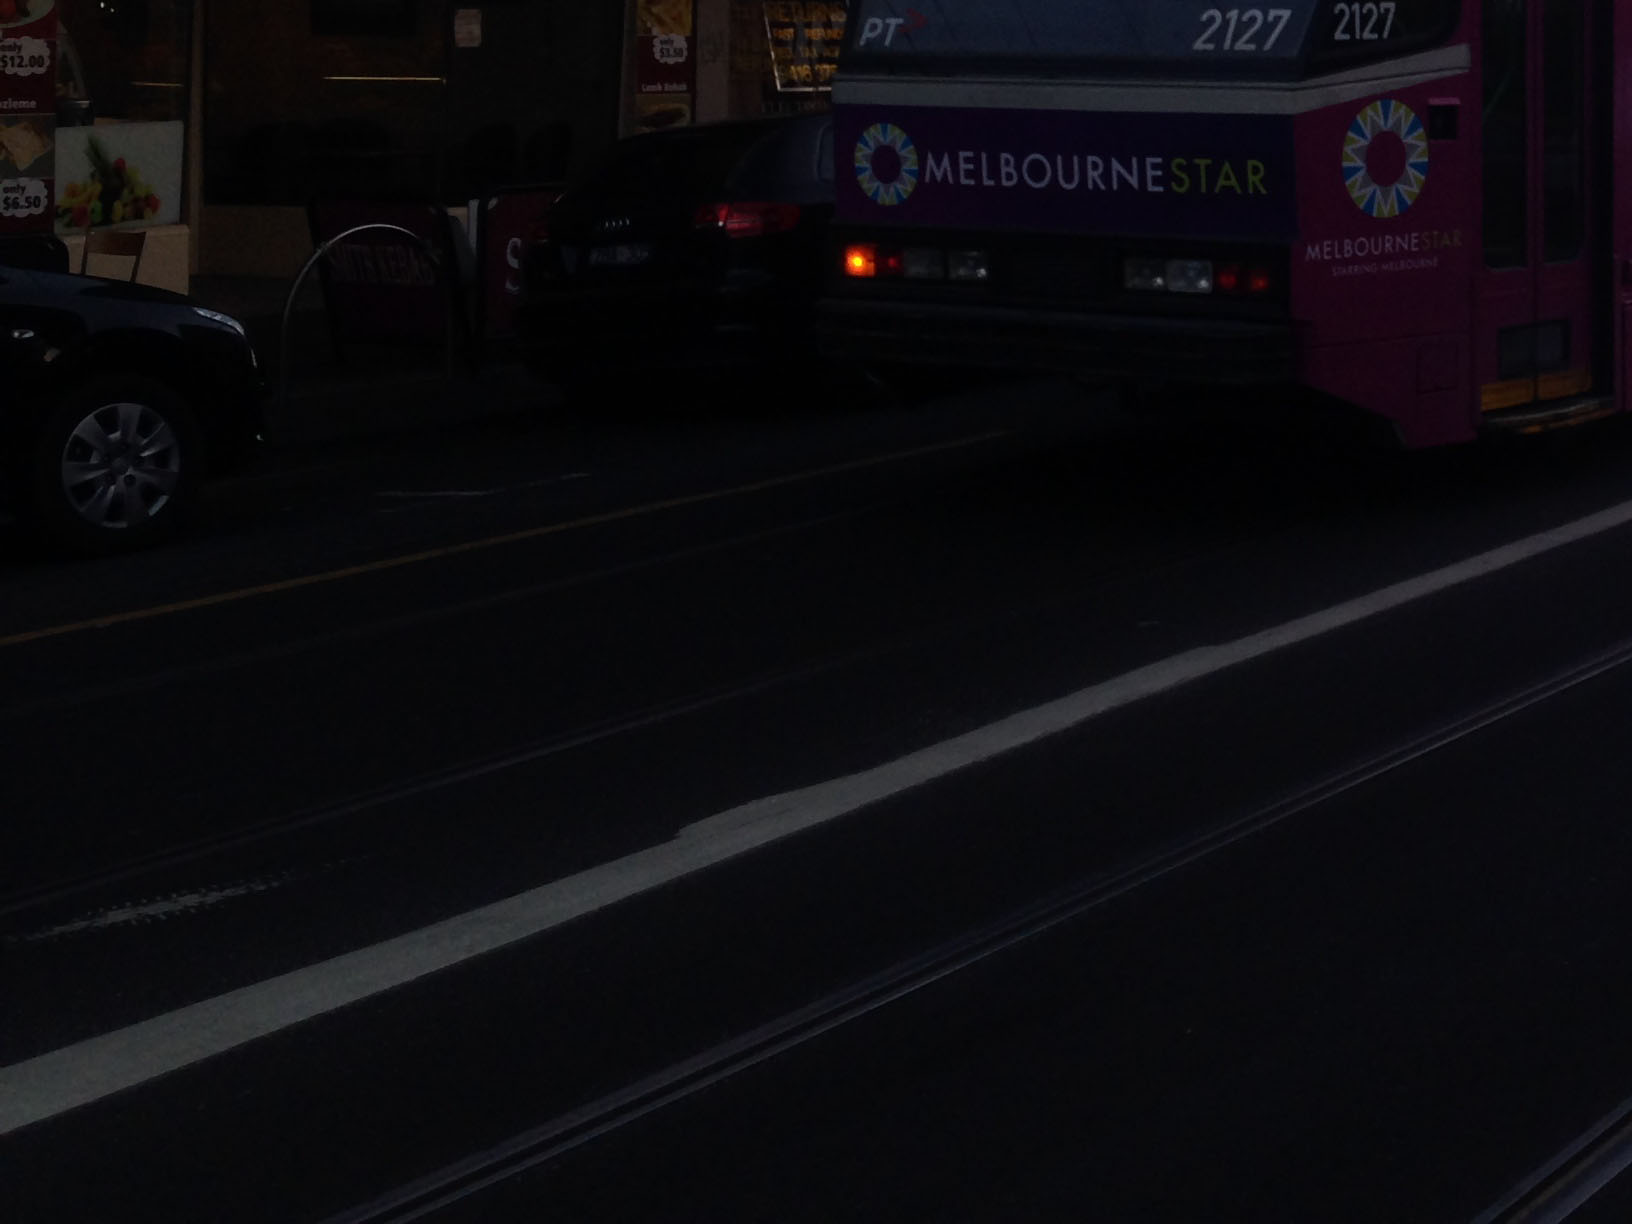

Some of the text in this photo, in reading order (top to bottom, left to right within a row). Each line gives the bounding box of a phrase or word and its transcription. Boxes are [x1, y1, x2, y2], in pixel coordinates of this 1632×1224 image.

[860, 17, 904, 47] PT
[1193, 2, 1396, 51] 2127 2127
[3, 196, 41, 210] $6.50
